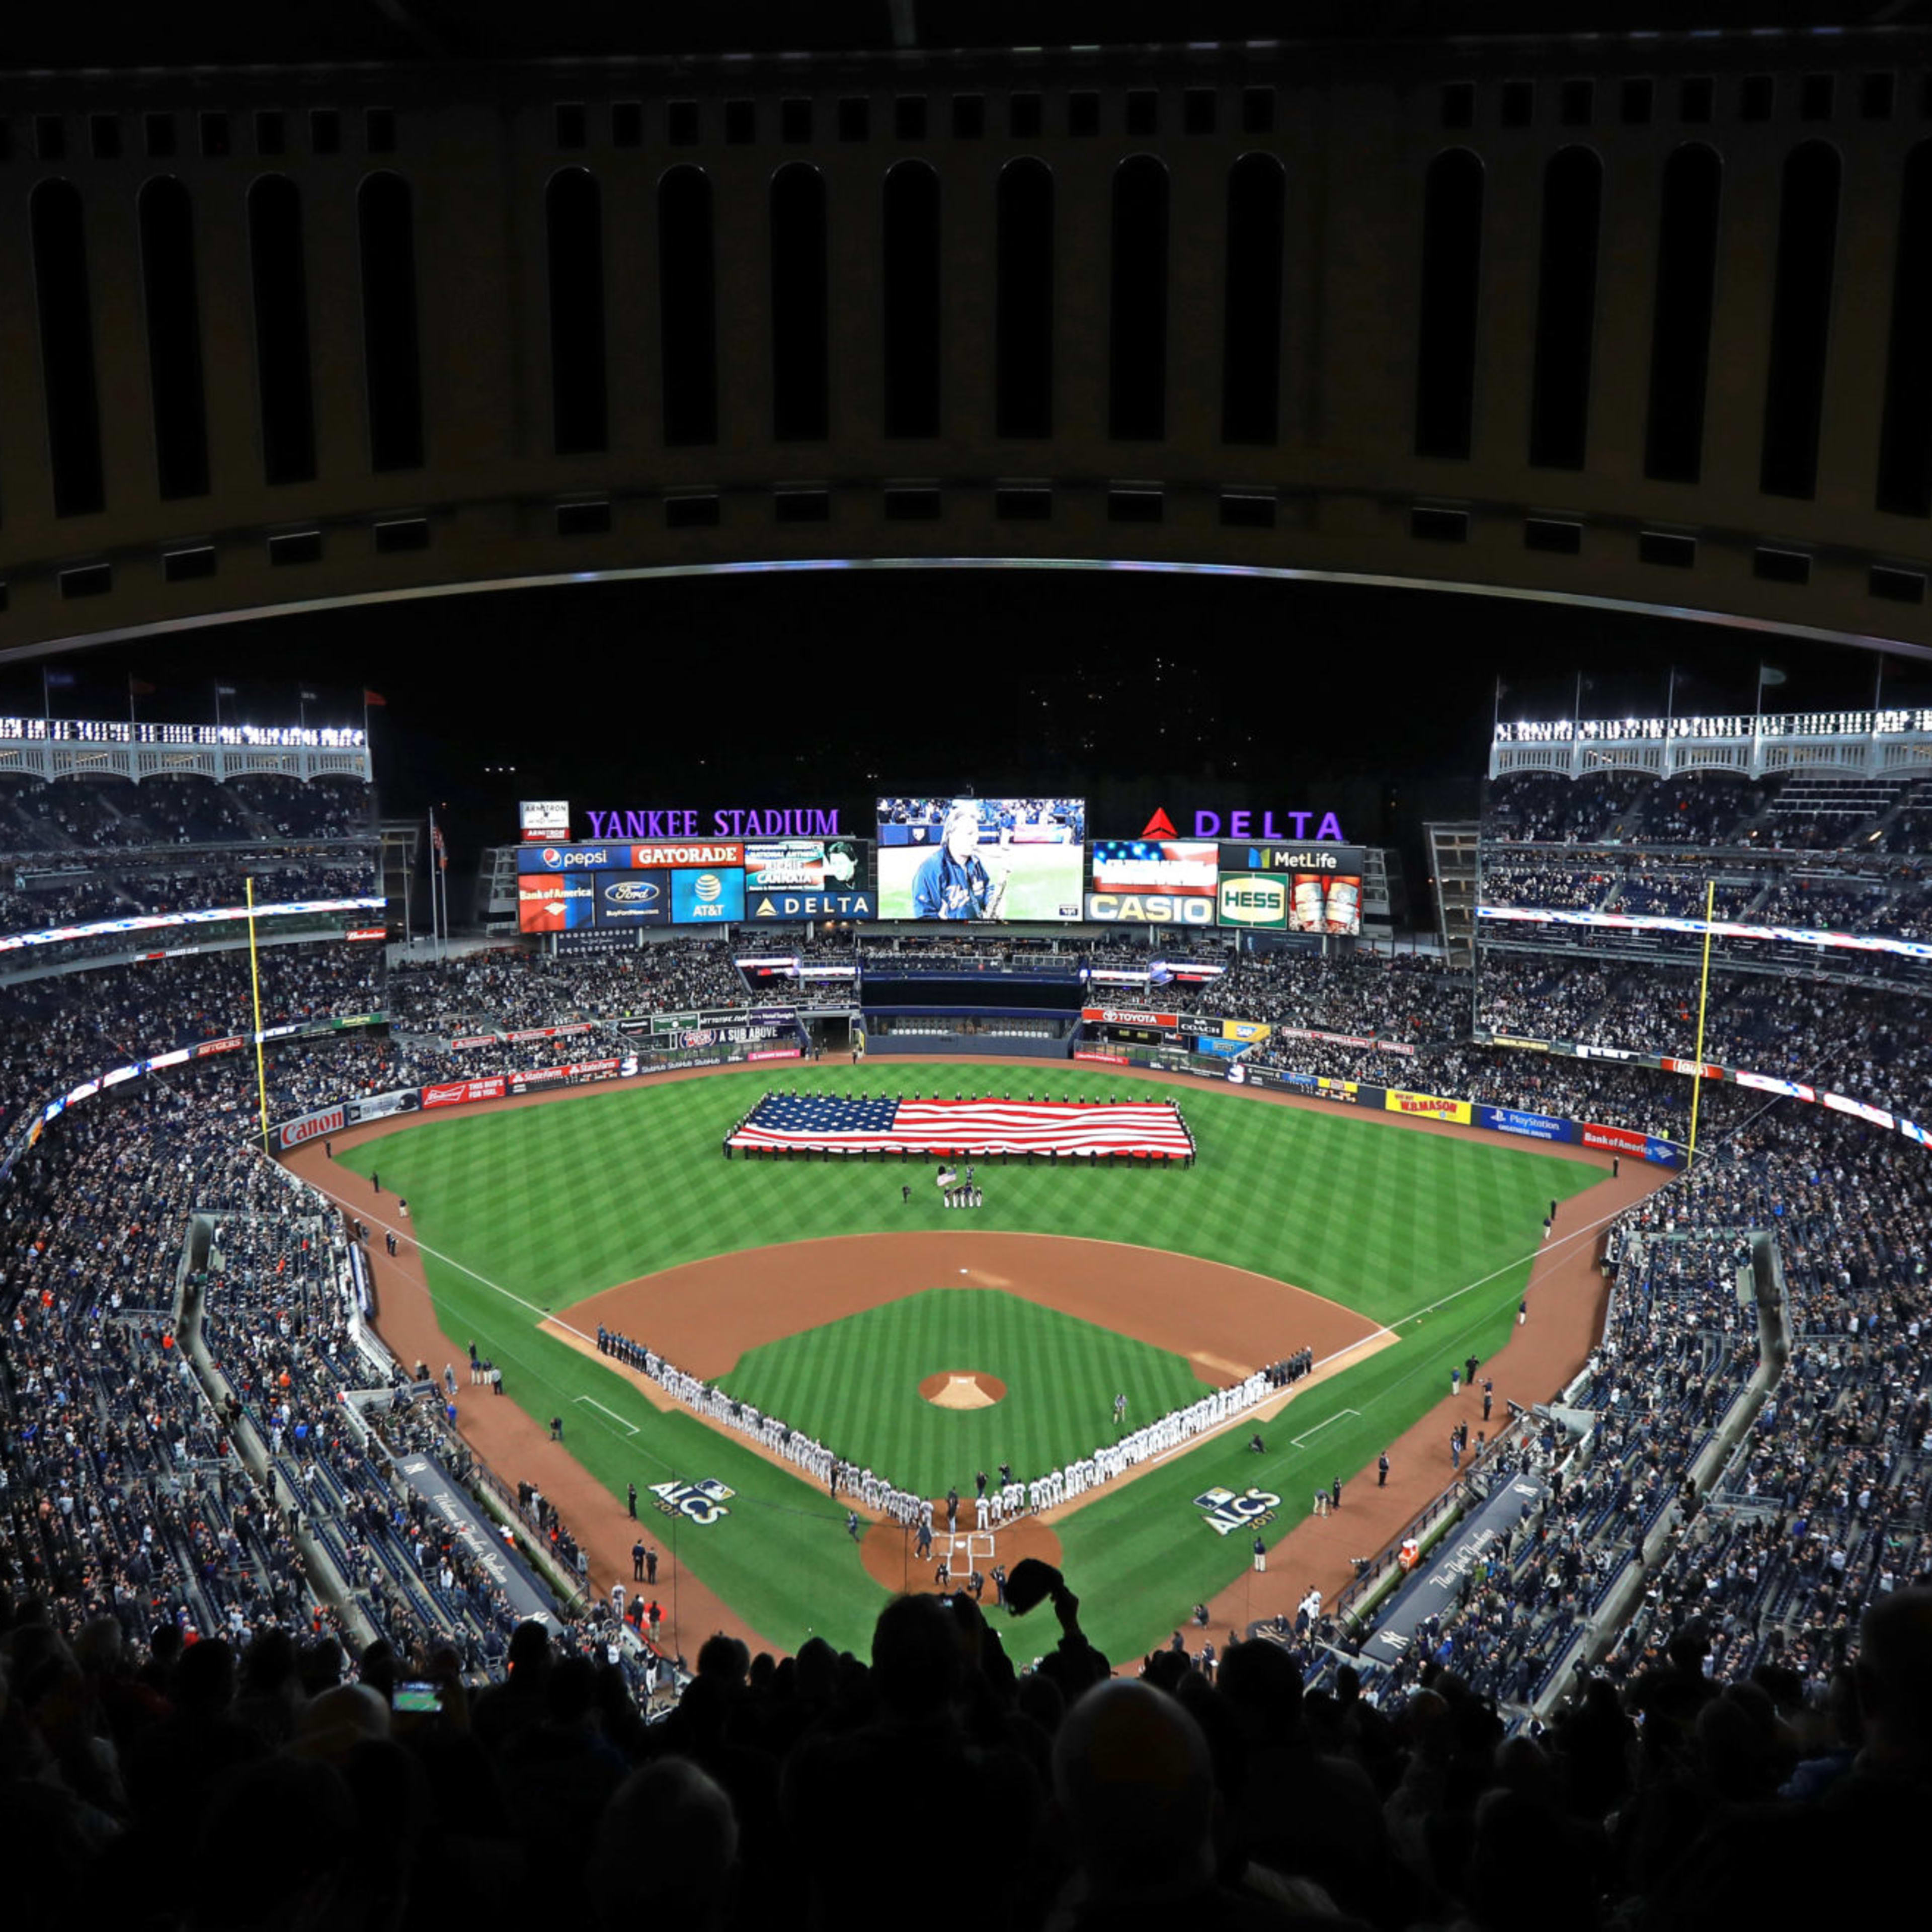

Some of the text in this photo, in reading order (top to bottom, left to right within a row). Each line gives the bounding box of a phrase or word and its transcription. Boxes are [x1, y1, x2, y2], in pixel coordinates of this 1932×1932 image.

[586, 810, 840, 838] YANKEE STADIUM
[1195, 811, 1343, 840] DELTA
[564, 848, 607, 867] pepsi
[638, 848, 737, 864] GATORADE
[1275, 852, 1337, 868] MetLife
[519, 887, 592, 900] Bank of America
[615, 885, 650, 899] Ford
[1225, 891, 1281, 908] HESS
[693, 905, 724, 917] AT&T
[784, 896, 869, 914] DELTA
[1089, 895, 1213, 922] CASIO
[1119, 1013, 1157, 1023] TOYOTA
[719, 1028, 726, 1042] A
[728, 1027, 747, 1041] SUB
[749, 1025, 778, 1040] ABOVE
[1181, 1023, 1220, 1034] COACH
[199, 1038, 242, 1055] RUTGERS
[668, 1061, 692, 1070] StubHub
[694, 1058, 720, 1067] StubHub
[524, 1069, 562, 1082] StateFarm
[468, 1082, 484, 1091] THIS
[468, 1090, 481, 1099] FOR
[281, 1109, 343, 1146] Canon
[1510, 1114, 1559, 1130] PlayStation
[1585, 1132, 1653, 1155] Bank of America
[1429, 1528, 1495, 1589] New York Yankees
